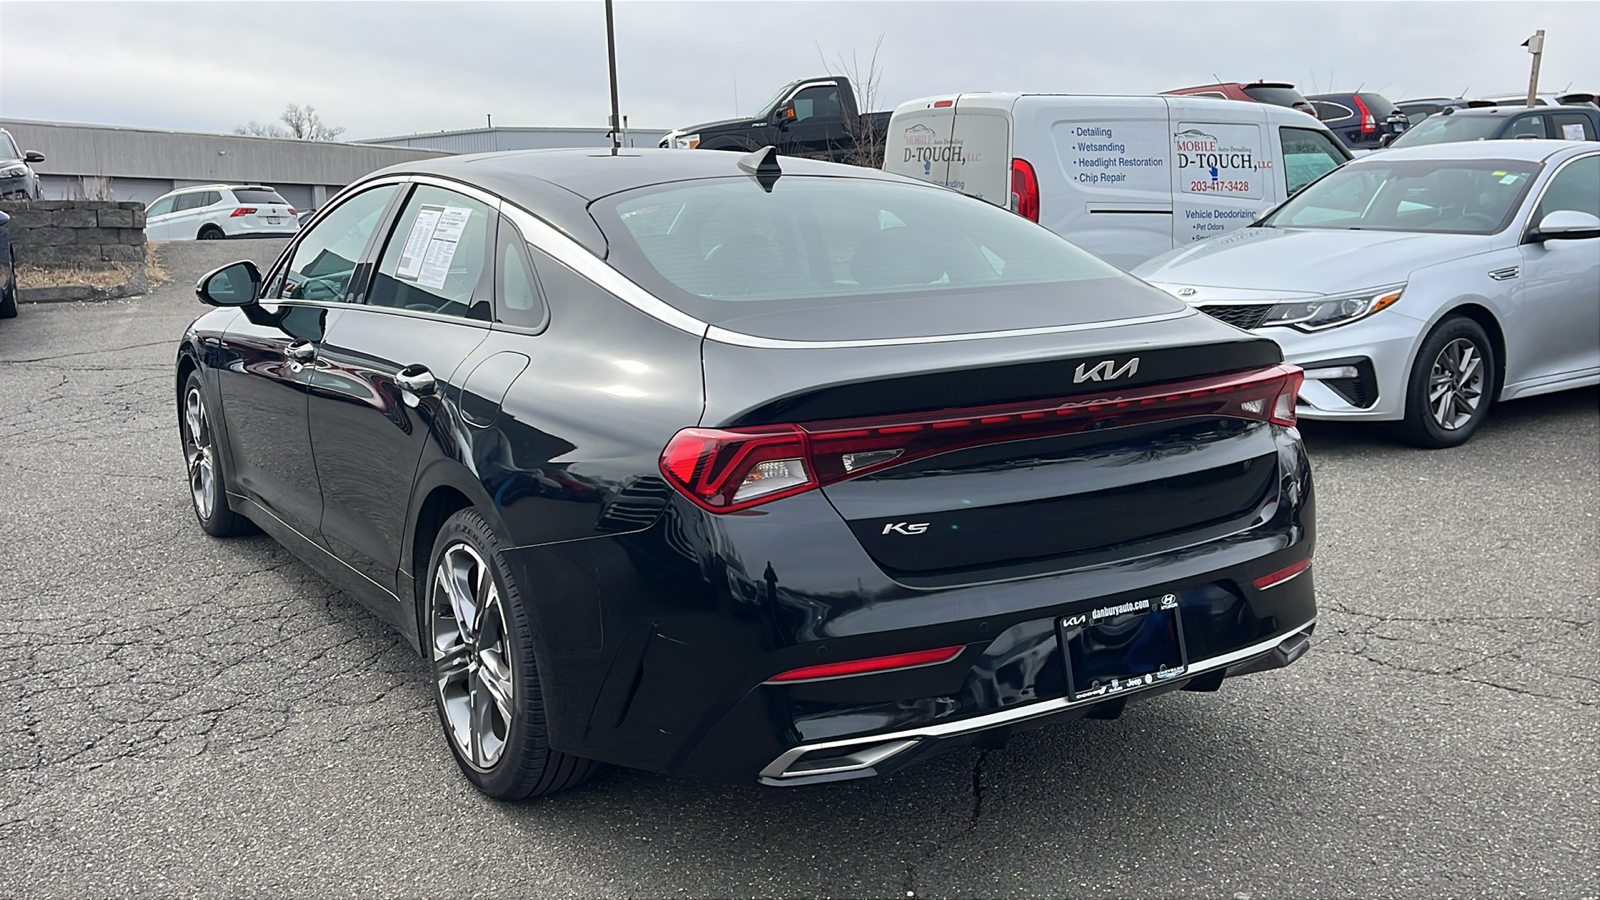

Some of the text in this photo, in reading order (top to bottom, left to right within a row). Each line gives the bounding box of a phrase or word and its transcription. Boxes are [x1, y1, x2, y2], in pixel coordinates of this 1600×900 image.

[1076, 127, 1112, 138] Detailing
[904, 134, 932, 145] MOBILE
[1077, 142, 1125, 153] Wetsanding
[1177, 140, 1216, 152] MOBILE
[1078, 157, 1163, 169] Headlight Restoration
[1258, 160, 1273, 169] LLC
[1079, 173, 1126, 184] Chip Repair
[1190, 180, 1249, 192] 203-417-3428
[1185, 209, 1213, 219] Vehicle
[1196, 223, 1225, 231] Pet Odors
[1073, 357, 1140, 384] KIA
[882, 522, 930, 535] K5
[1091, 599, 1150, 619] danburyauto.com
[1063, 615, 1086, 627] KIA
[1126, 677, 1142, 688] Jeep
